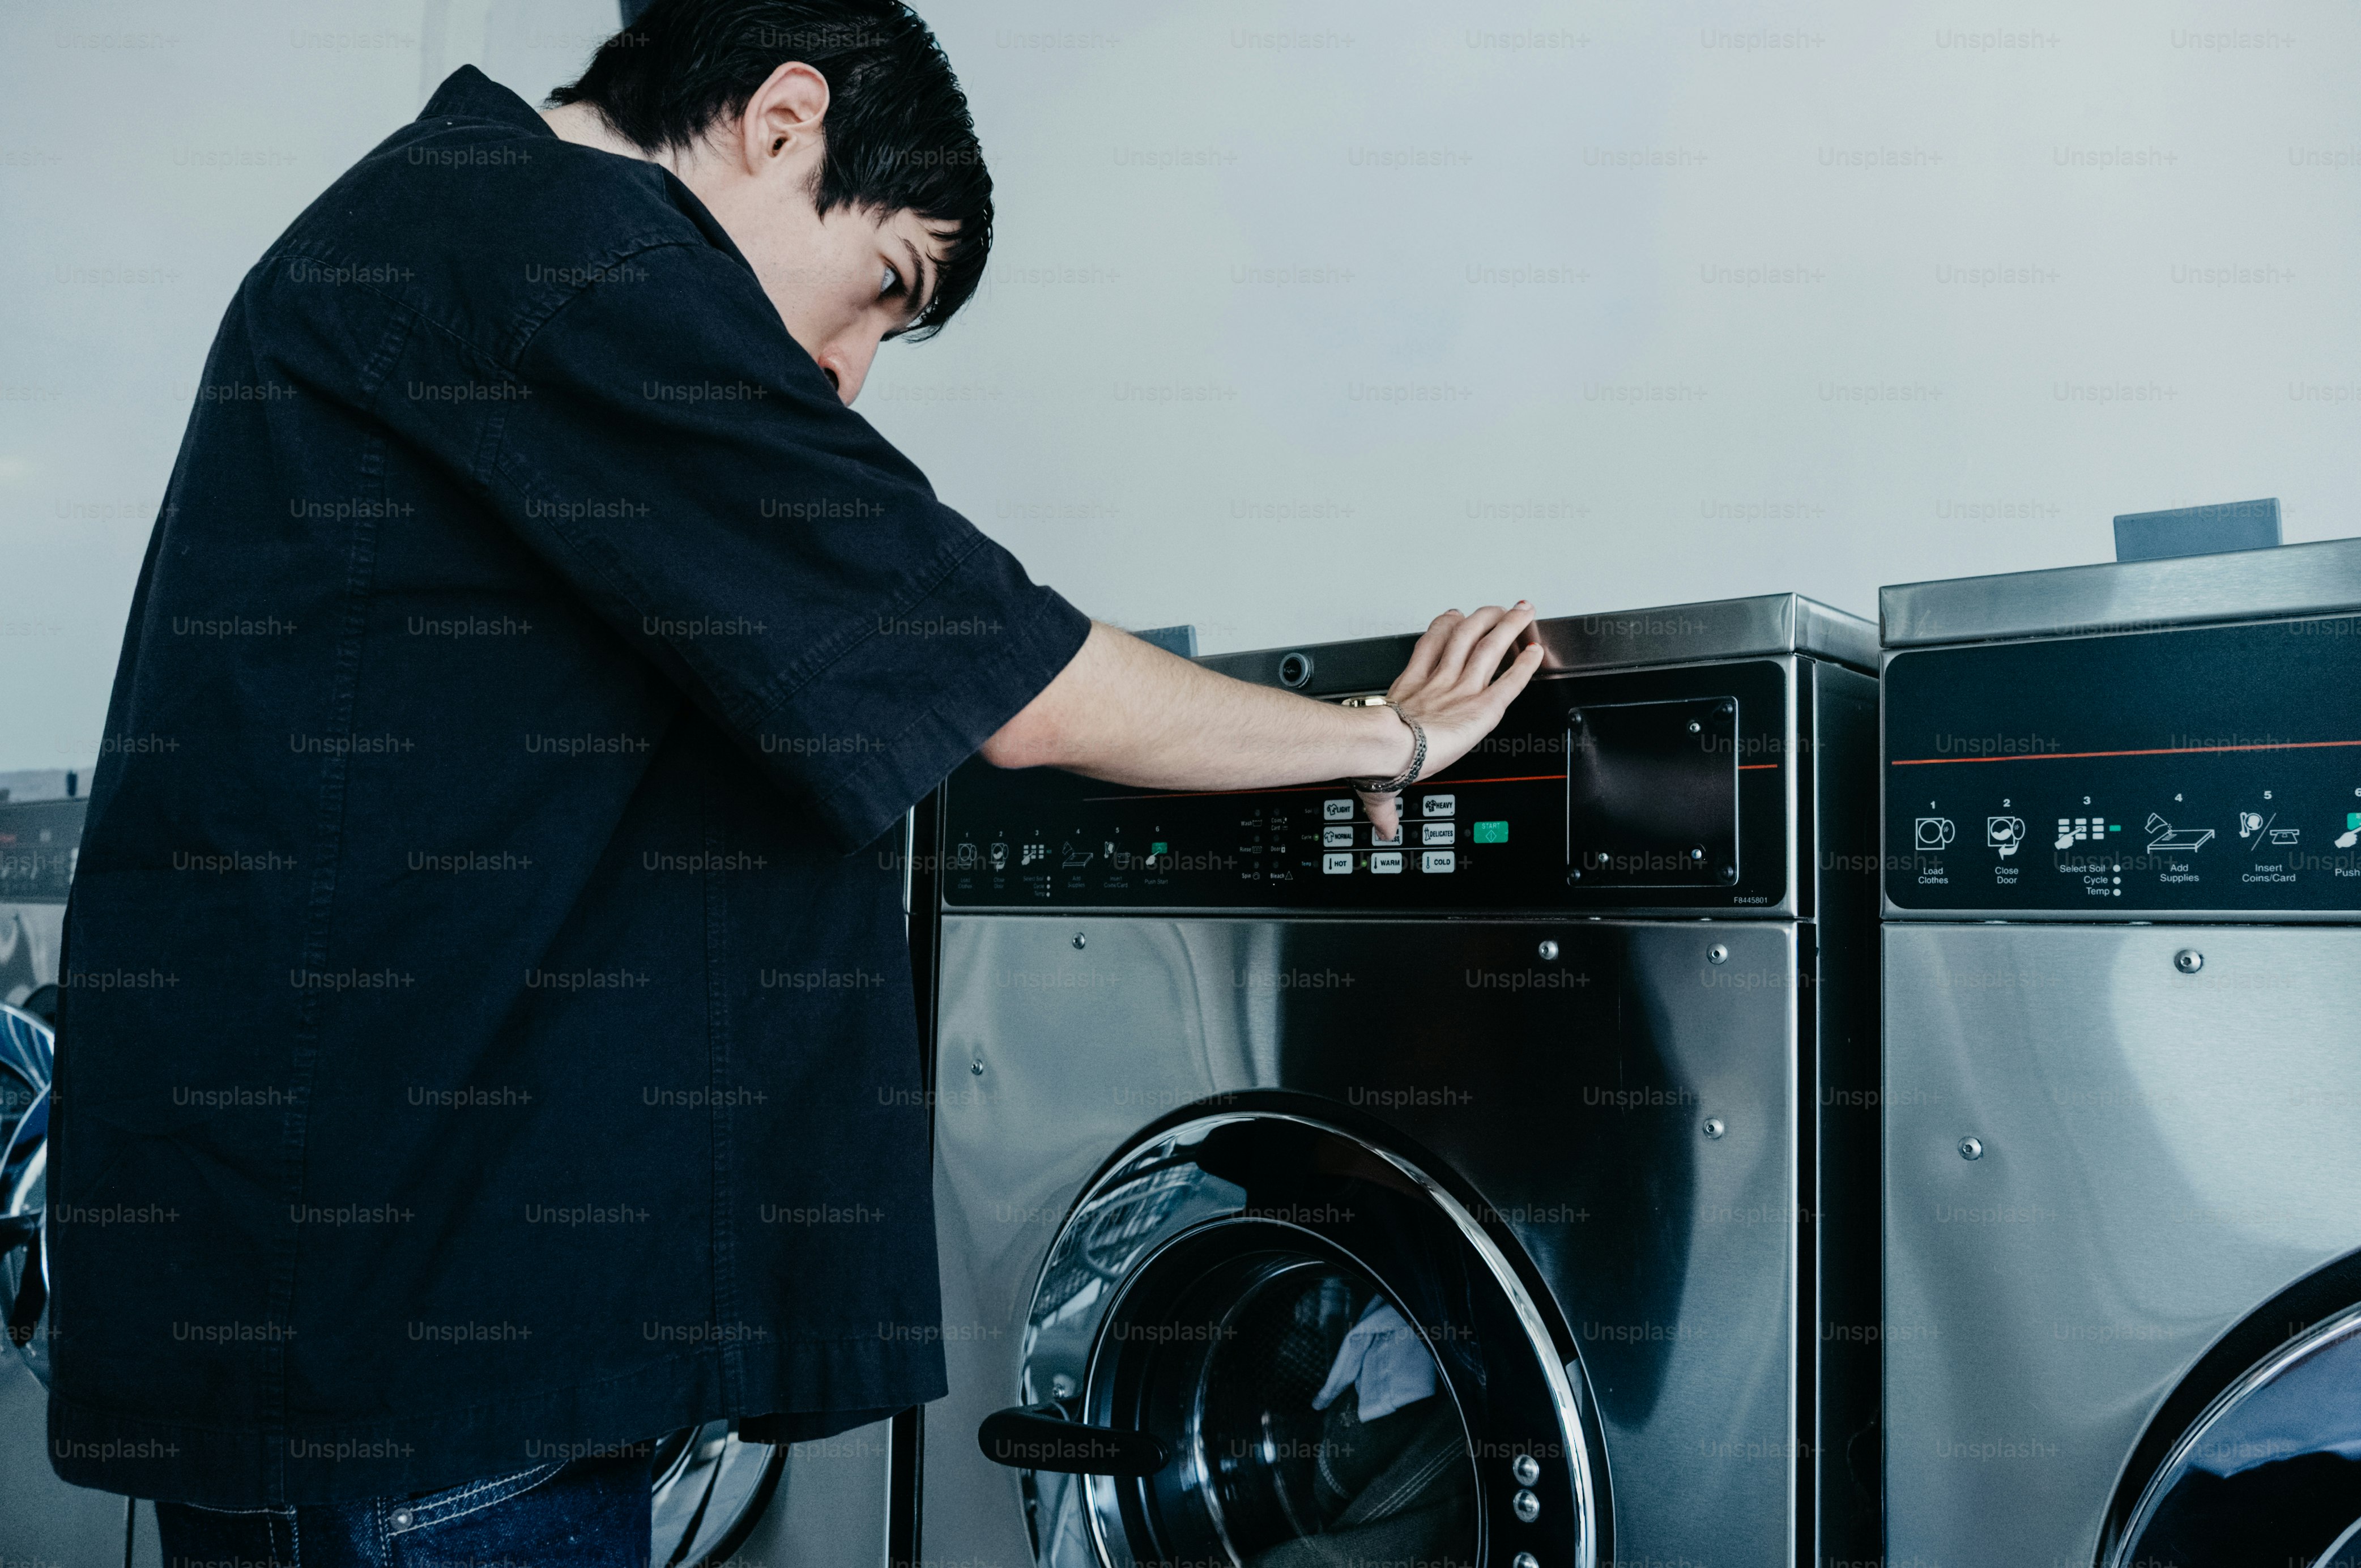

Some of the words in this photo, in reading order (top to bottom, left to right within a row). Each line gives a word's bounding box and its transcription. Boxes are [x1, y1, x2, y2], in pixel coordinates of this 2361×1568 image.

[2264, 791, 2272, 799] 5
[2354, 788, 2361, 797] 6
[2083, 796, 2091, 805] 3
[2174, 793, 2183, 802] 4
[1930, 800, 1936, 809] 1
[2003, 799, 2010, 807] 2
[2083, 876, 2108, 885] Cycle
[2160, 874, 2200, 883] Supplies
[2242, 874, 2296, 883] Coins/Card
[2086, 887, 2110, 896] Temp
